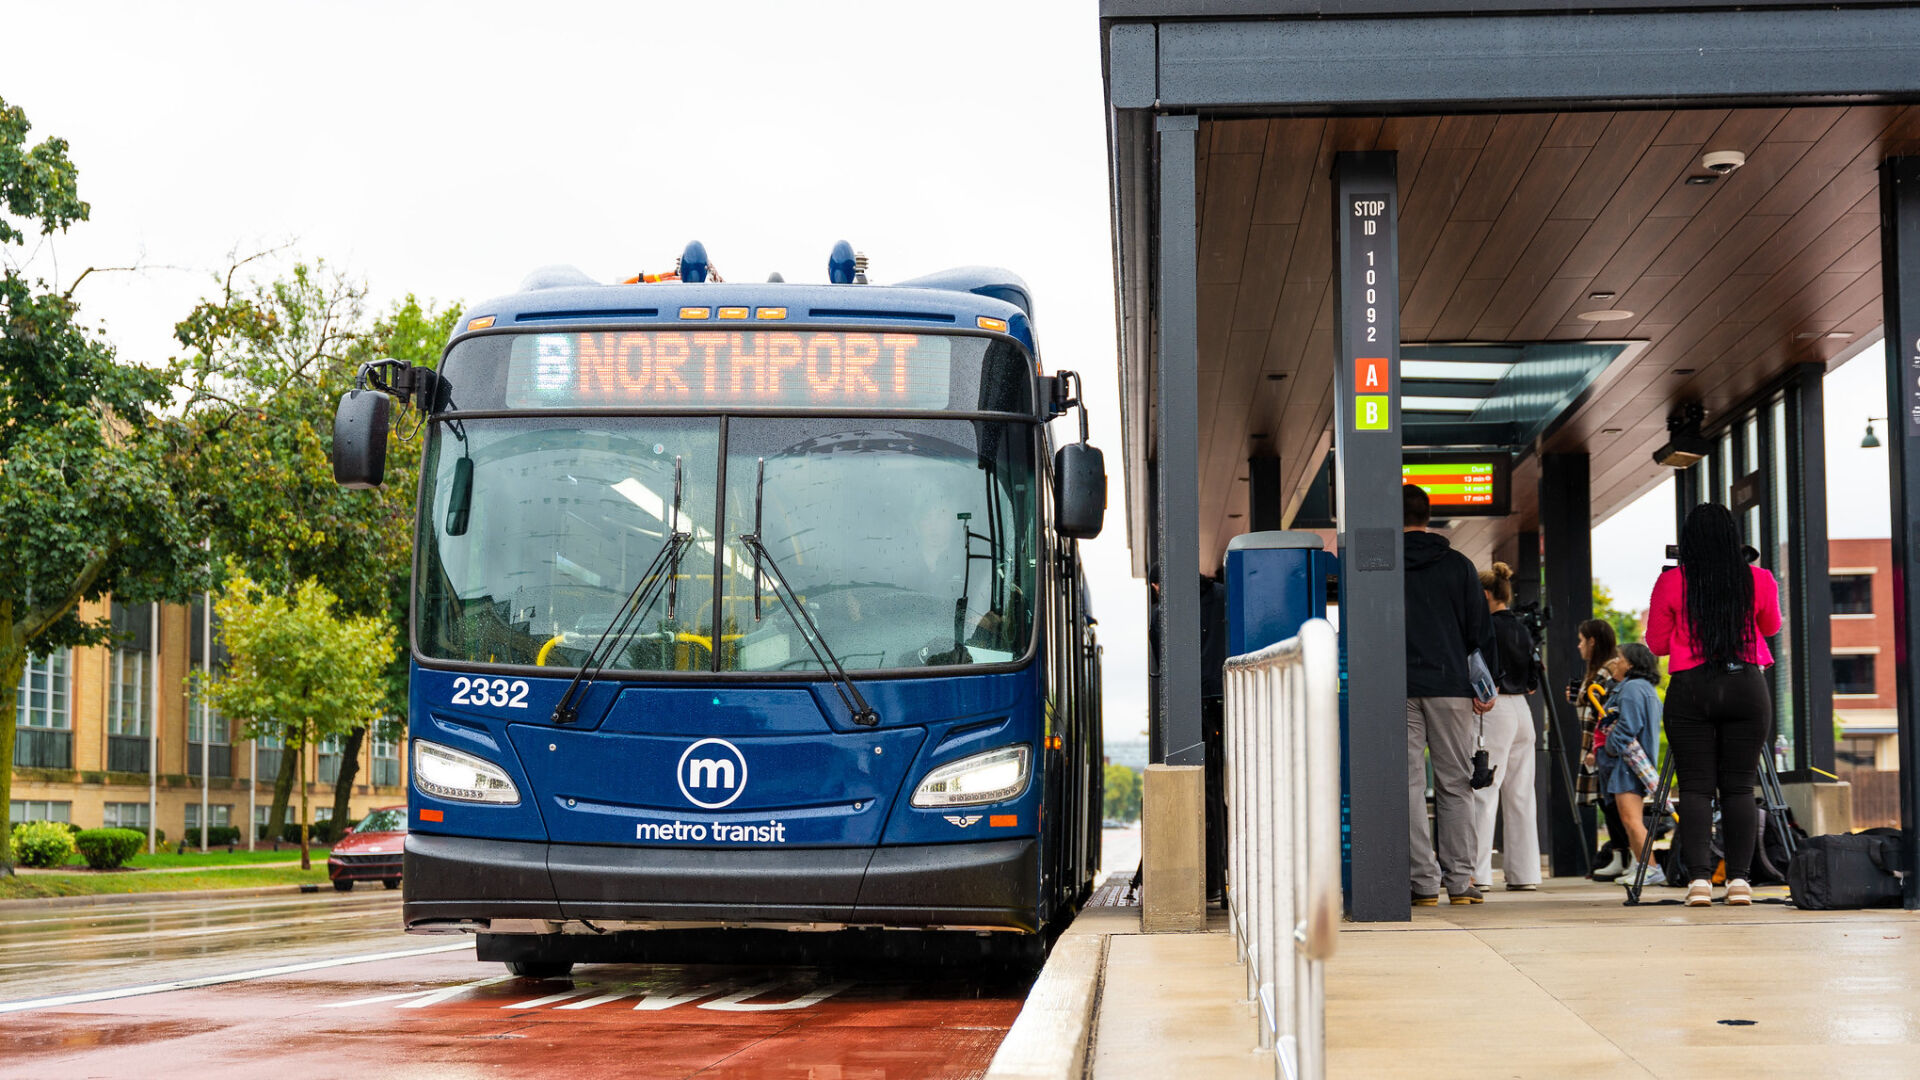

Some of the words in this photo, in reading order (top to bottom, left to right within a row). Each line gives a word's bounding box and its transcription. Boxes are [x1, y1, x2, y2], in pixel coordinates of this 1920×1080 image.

[1354, 201, 1385, 217] STOP
[1364, 220, 1376, 235] ID
[1366, 251, 1376, 342] 10092
[536, 333, 569, 392] B
[577, 332, 918, 393] NORTHPORT
[1366, 364, 1378, 387] A
[1366, 402, 1378, 424] B
[451, 677, 529, 708] 2332
[689, 758, 735, 789] m
[636, 820, 707, 841] metro
[711, 819, 786, 842] transit
